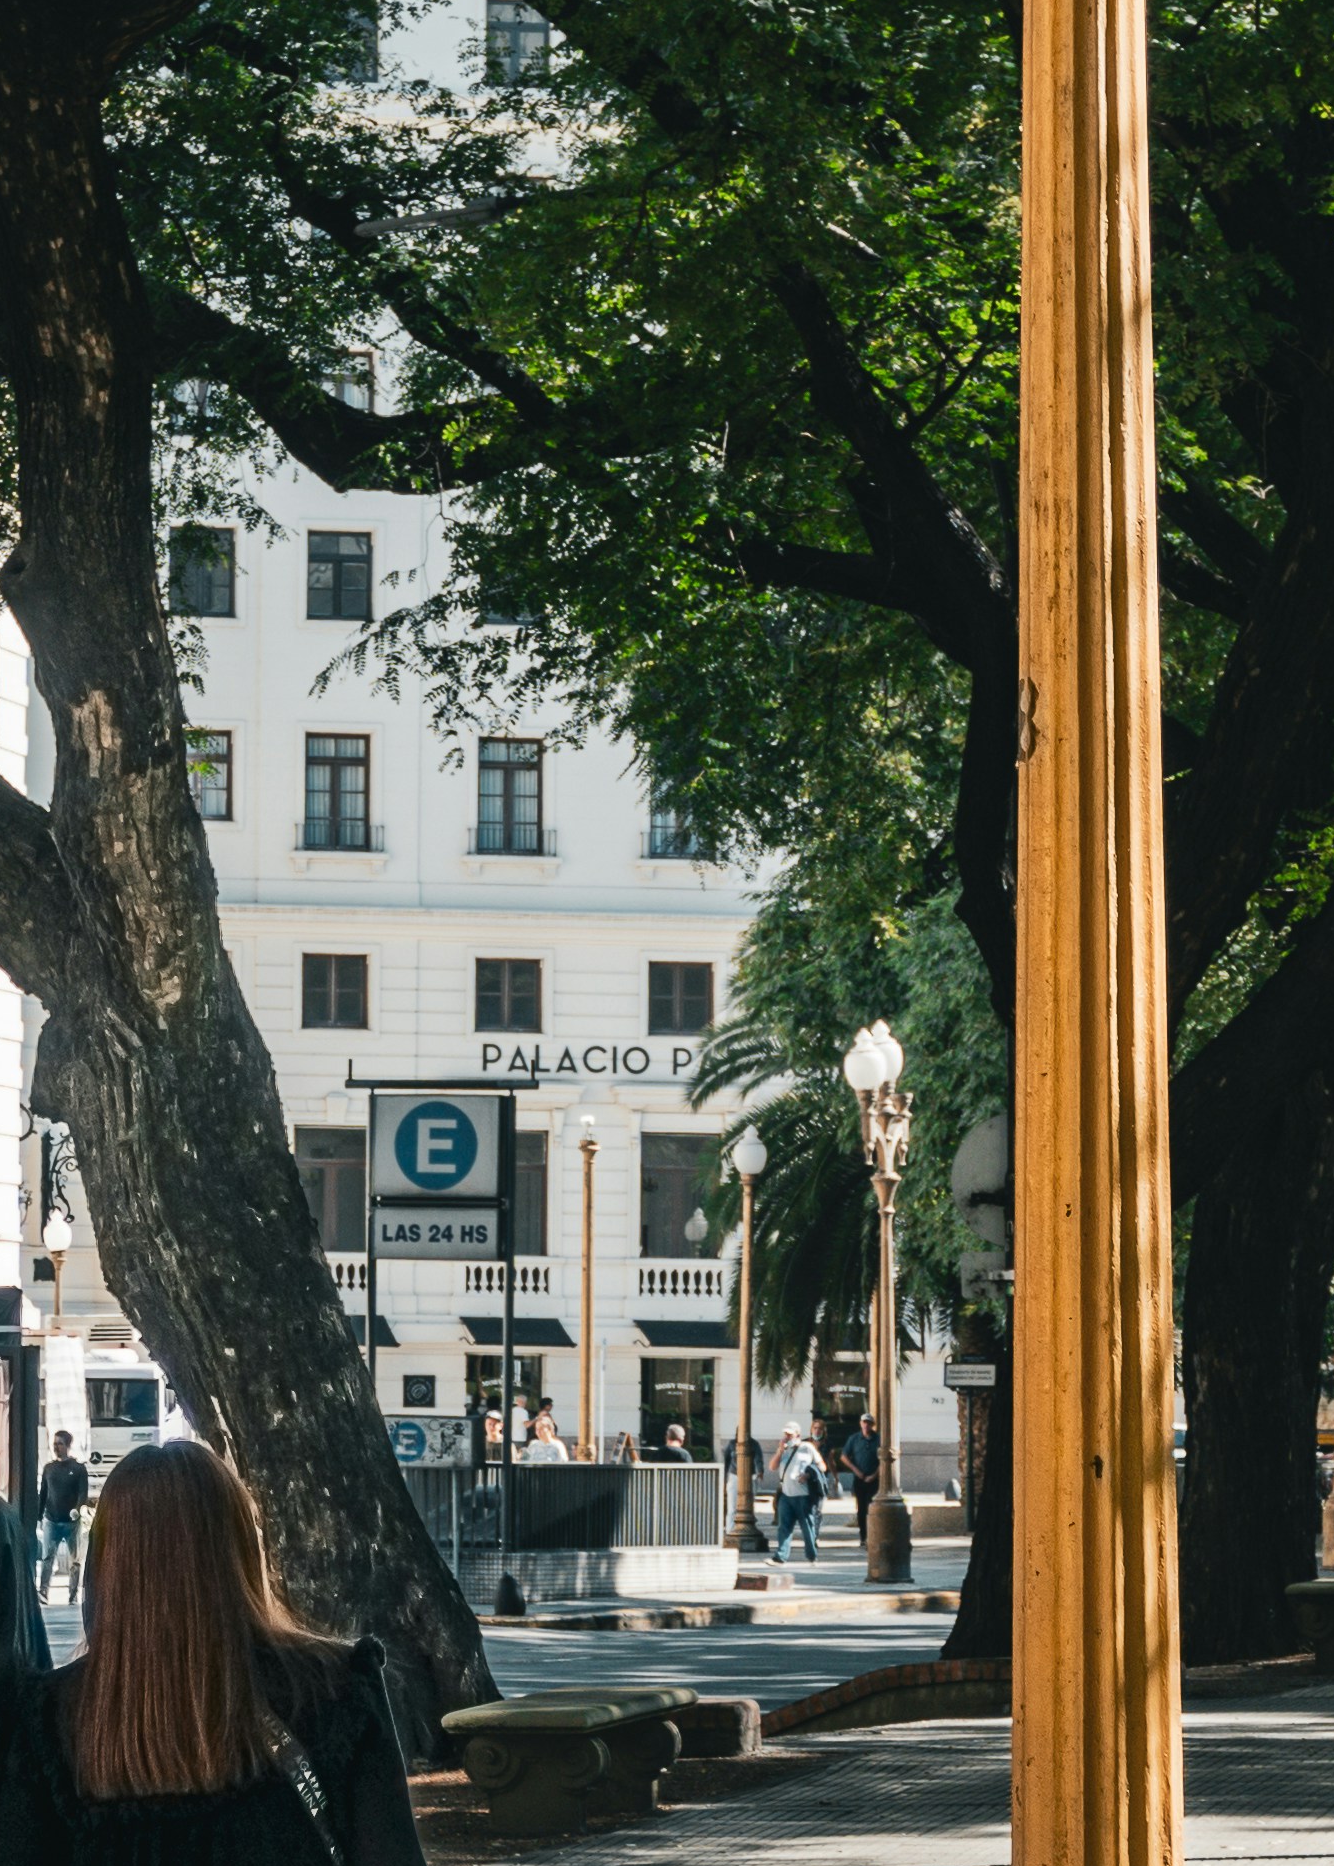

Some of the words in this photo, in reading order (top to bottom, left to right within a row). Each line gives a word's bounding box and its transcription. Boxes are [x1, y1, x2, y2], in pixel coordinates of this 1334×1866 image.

[482, 1043, 650, 1075] PALACIO
[416, 1118, 458, 1174] E
[382, 1224, 421, 1243] LAS
[428, 1224, 453, 1243] 24
[460, 1224, 488, 1244] HS
